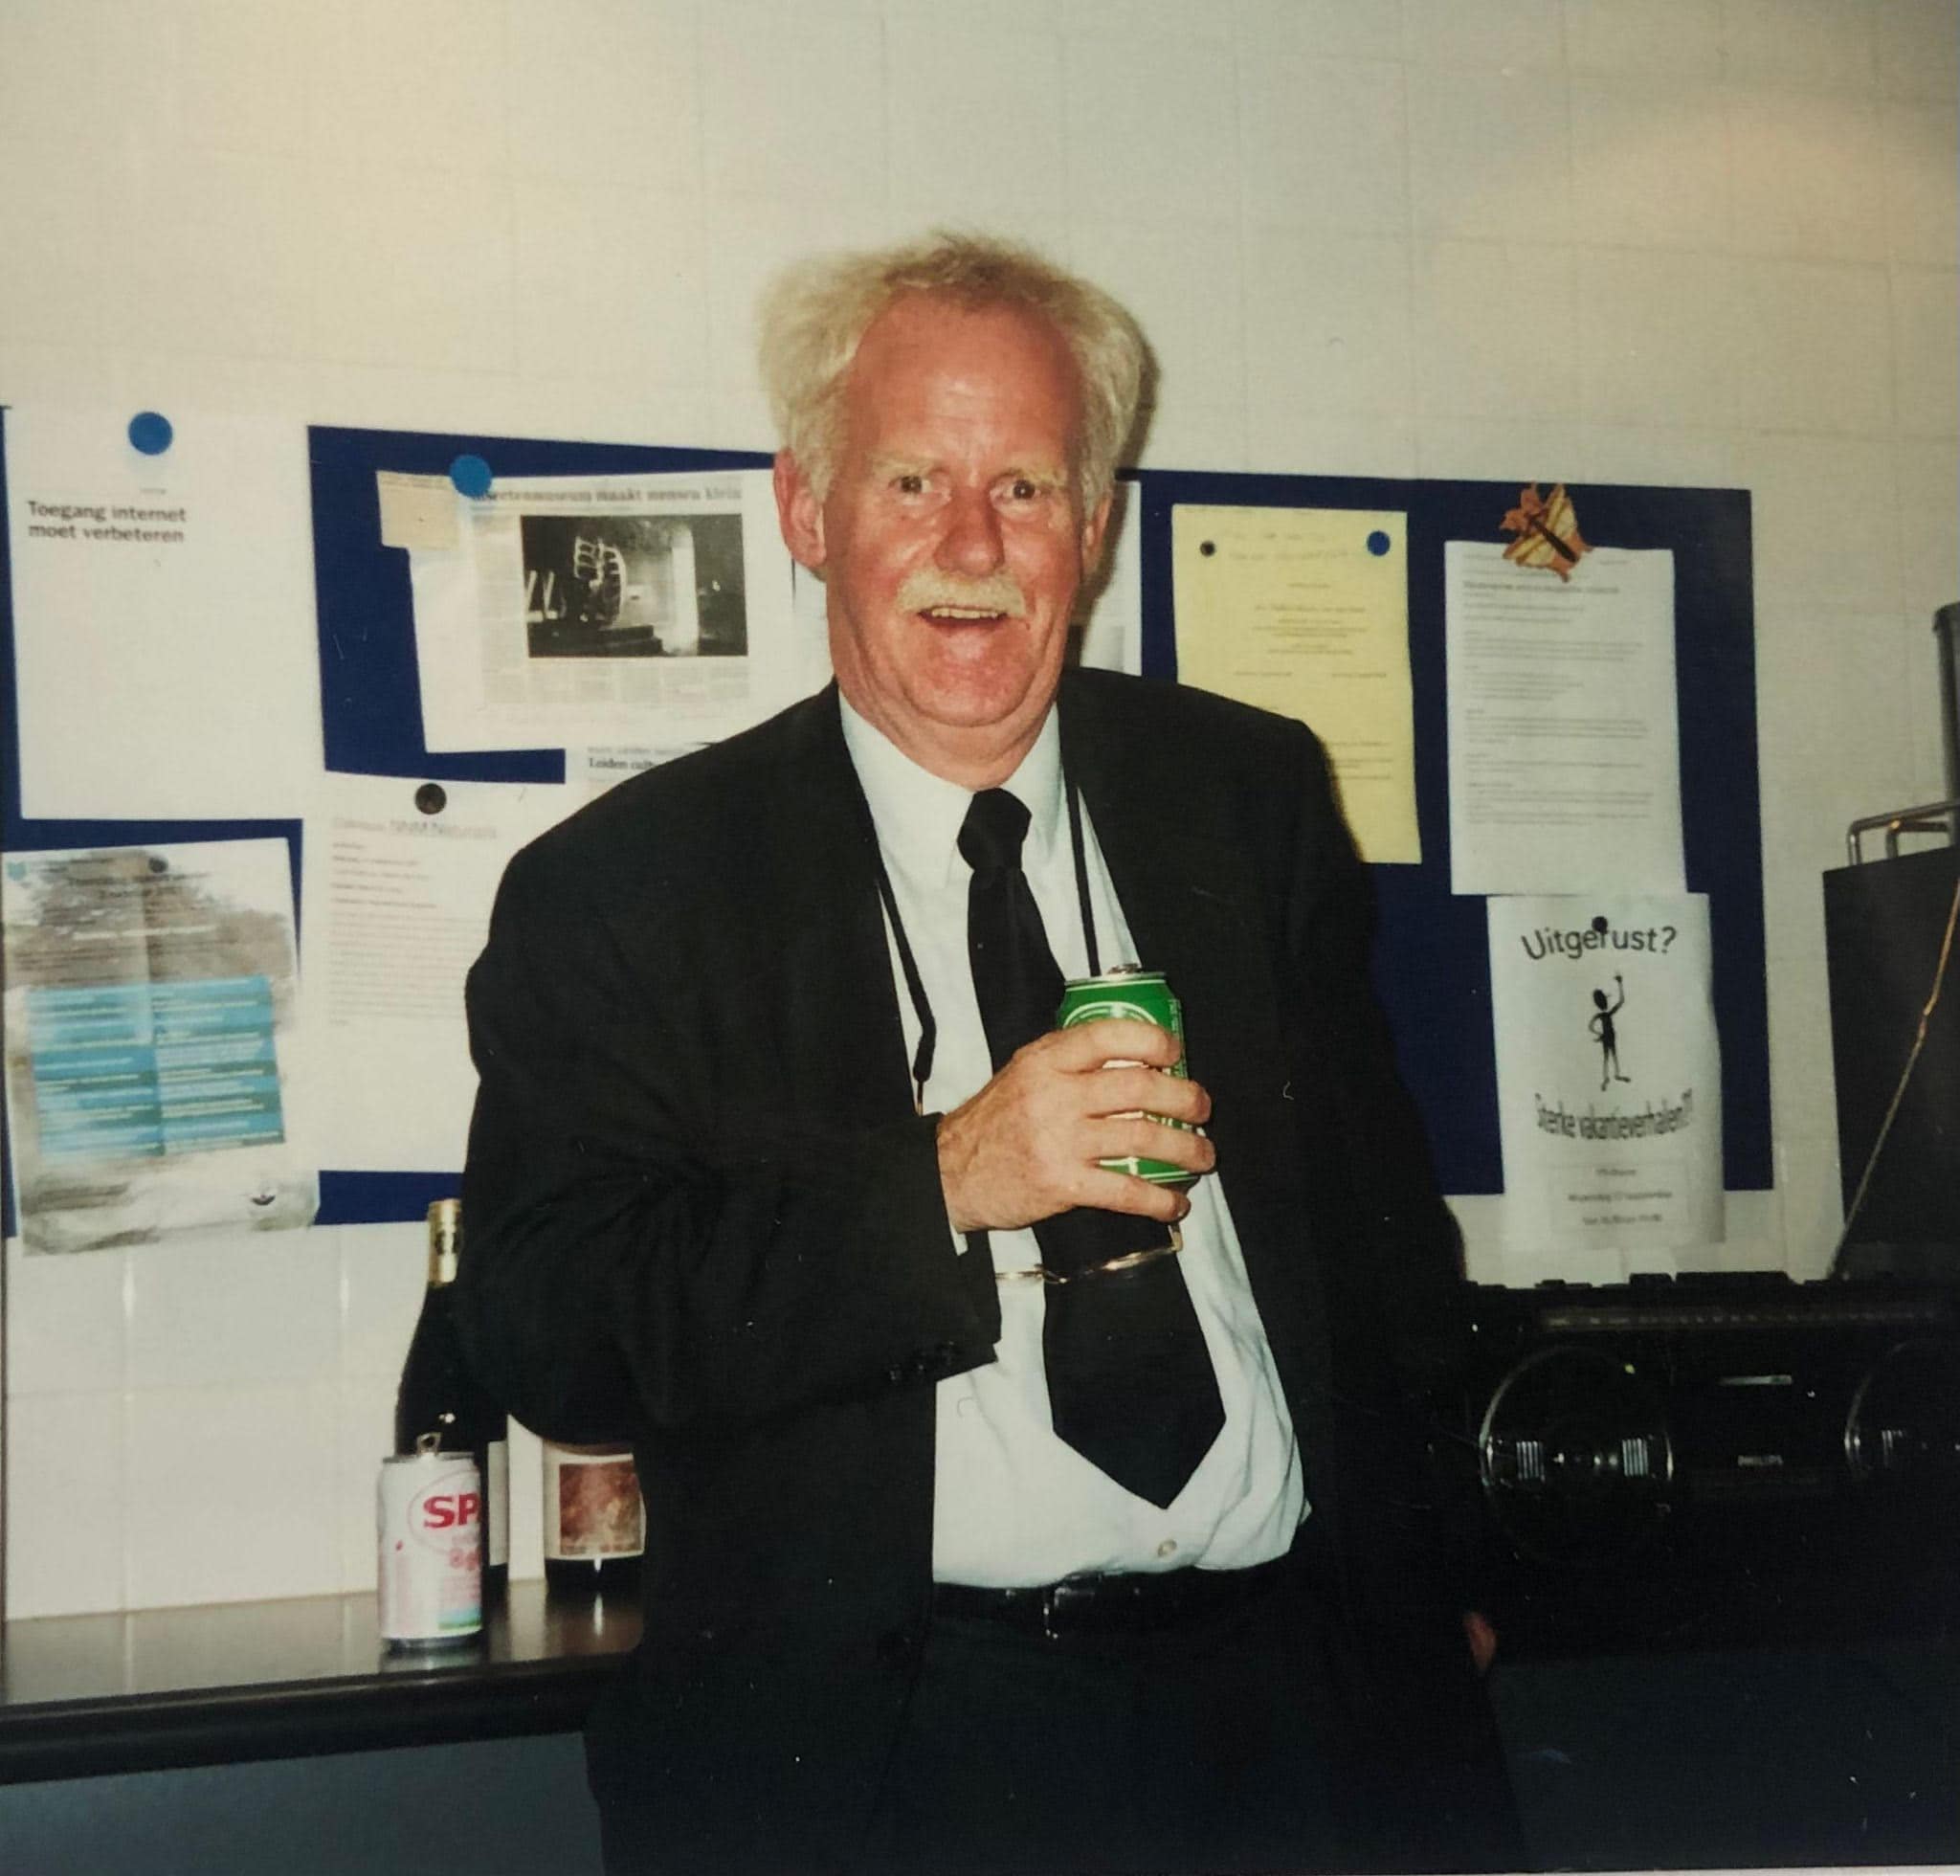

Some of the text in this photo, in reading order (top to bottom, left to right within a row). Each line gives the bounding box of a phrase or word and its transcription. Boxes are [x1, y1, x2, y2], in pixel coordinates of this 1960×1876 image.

[27, 500, 187, 523] Toegang internet
[28, 525, 185, 543] moet verbeteren
[1521, 926, 1679, 960] Uitgerust?
